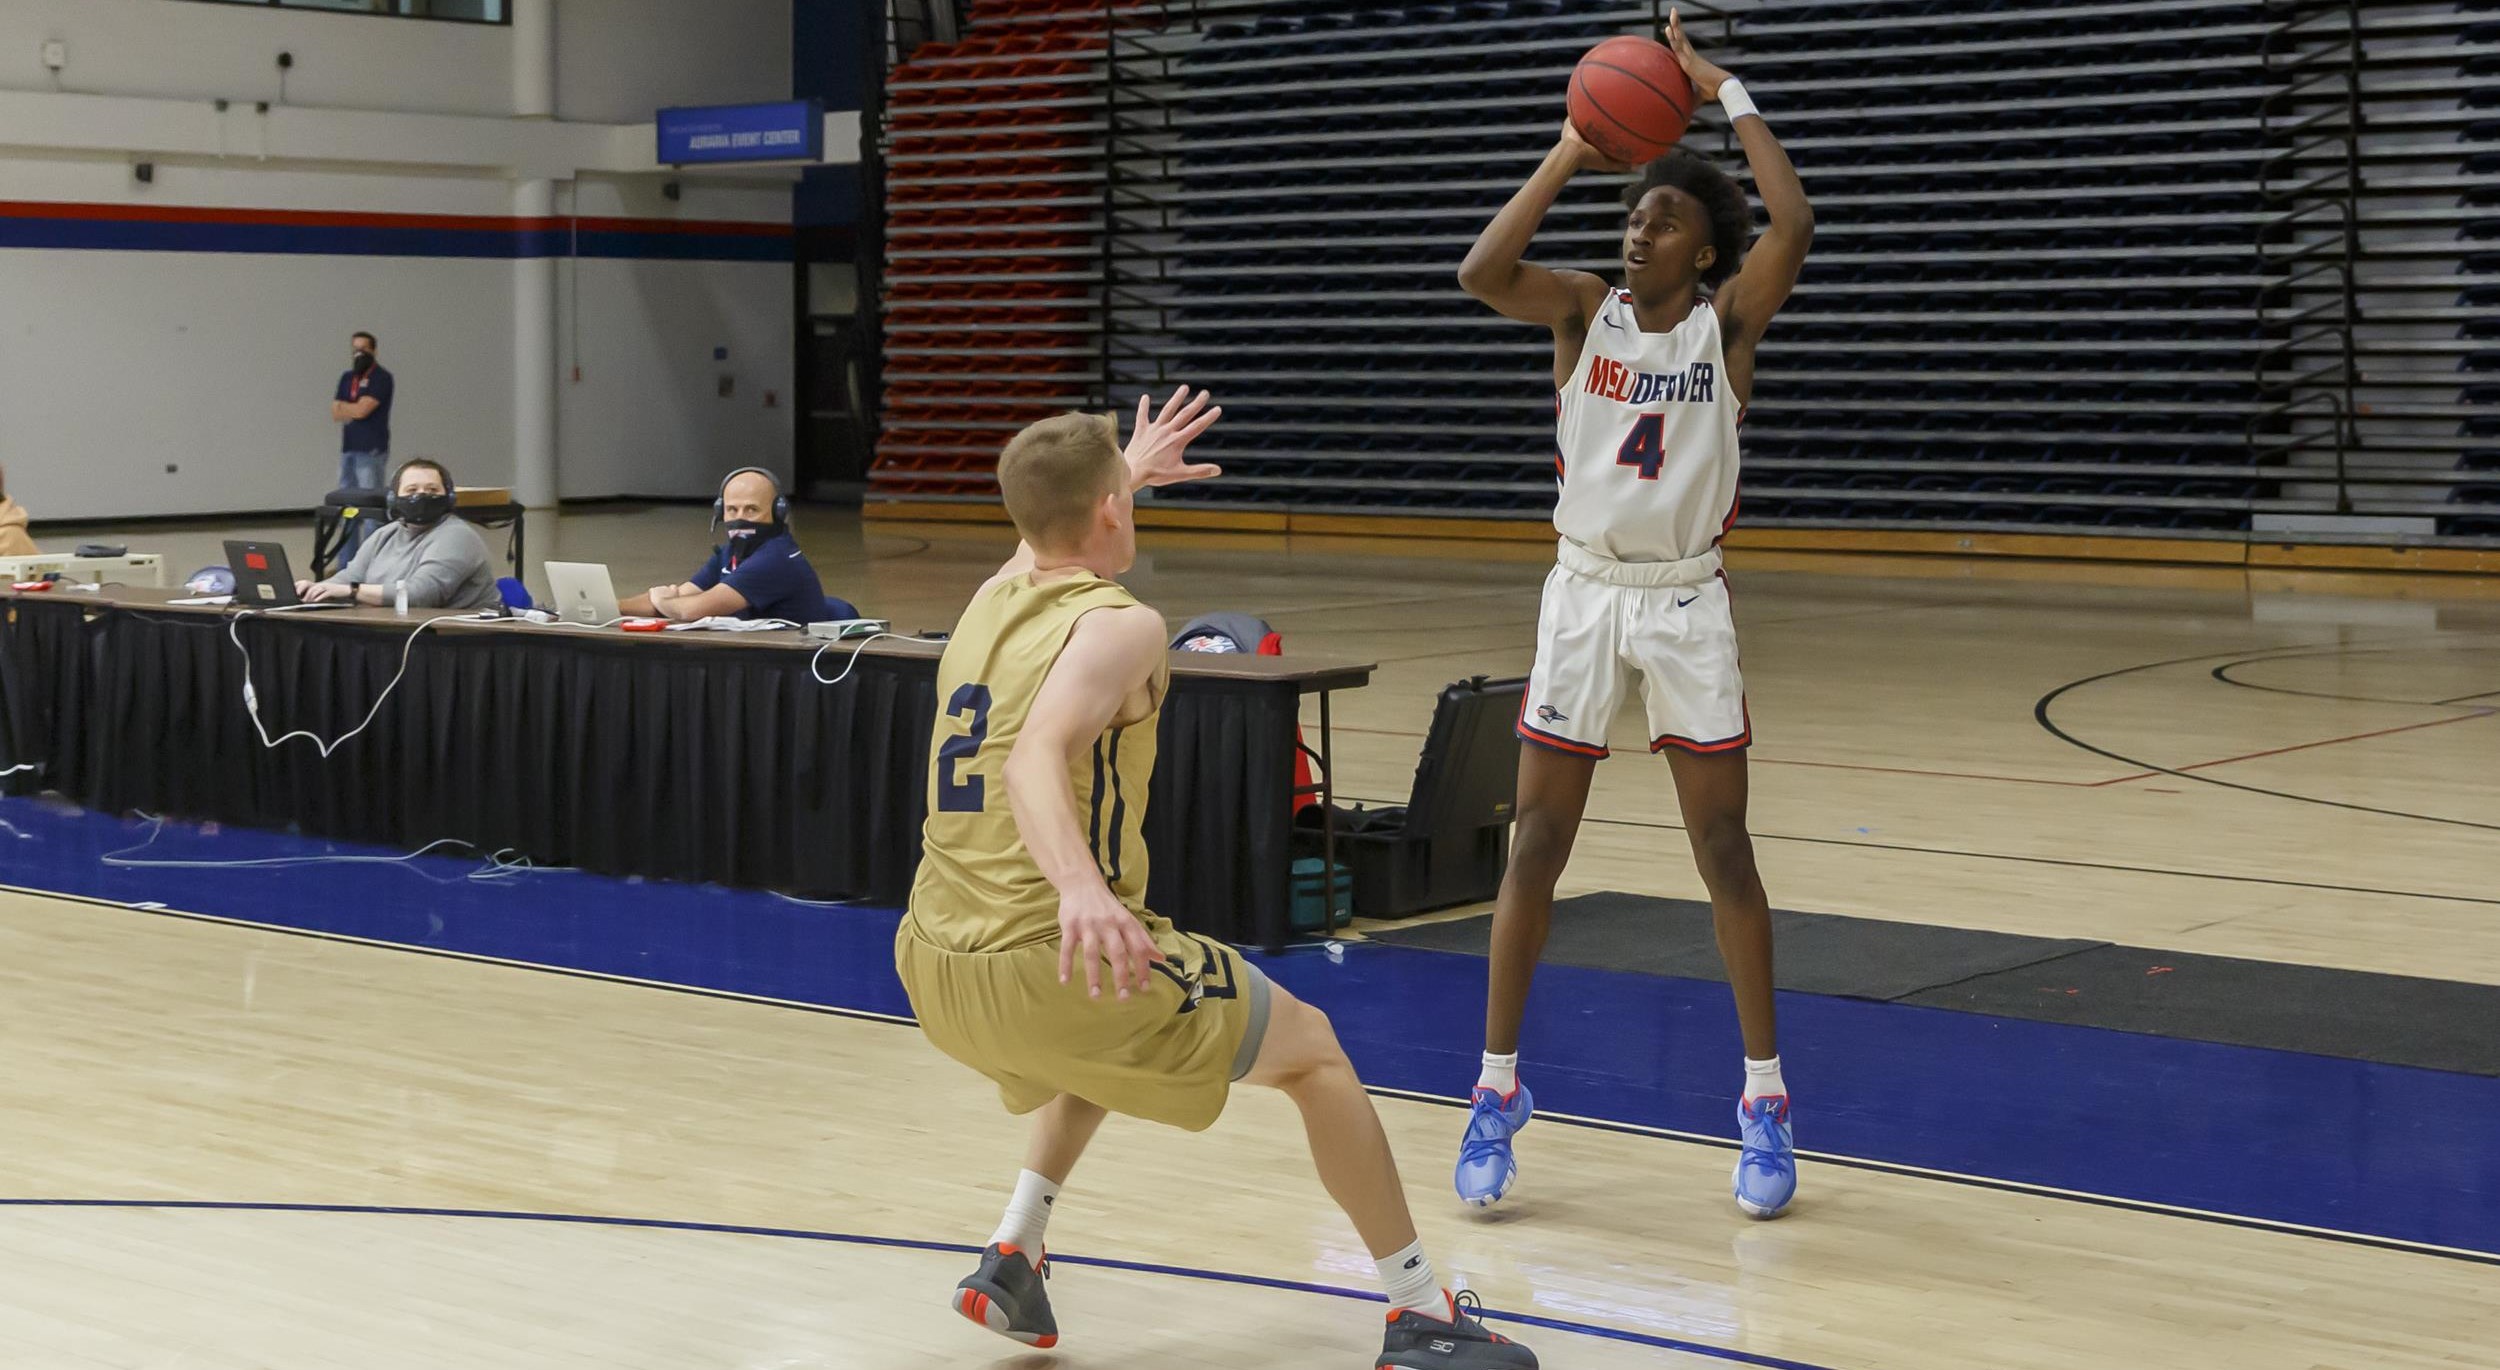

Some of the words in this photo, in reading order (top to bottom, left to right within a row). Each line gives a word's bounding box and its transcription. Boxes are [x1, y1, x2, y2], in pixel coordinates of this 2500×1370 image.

[763, 129, 800, 146] CENTER
[1616, 413, 1666, 480] 4
[937, 682, 993, 813] 2
